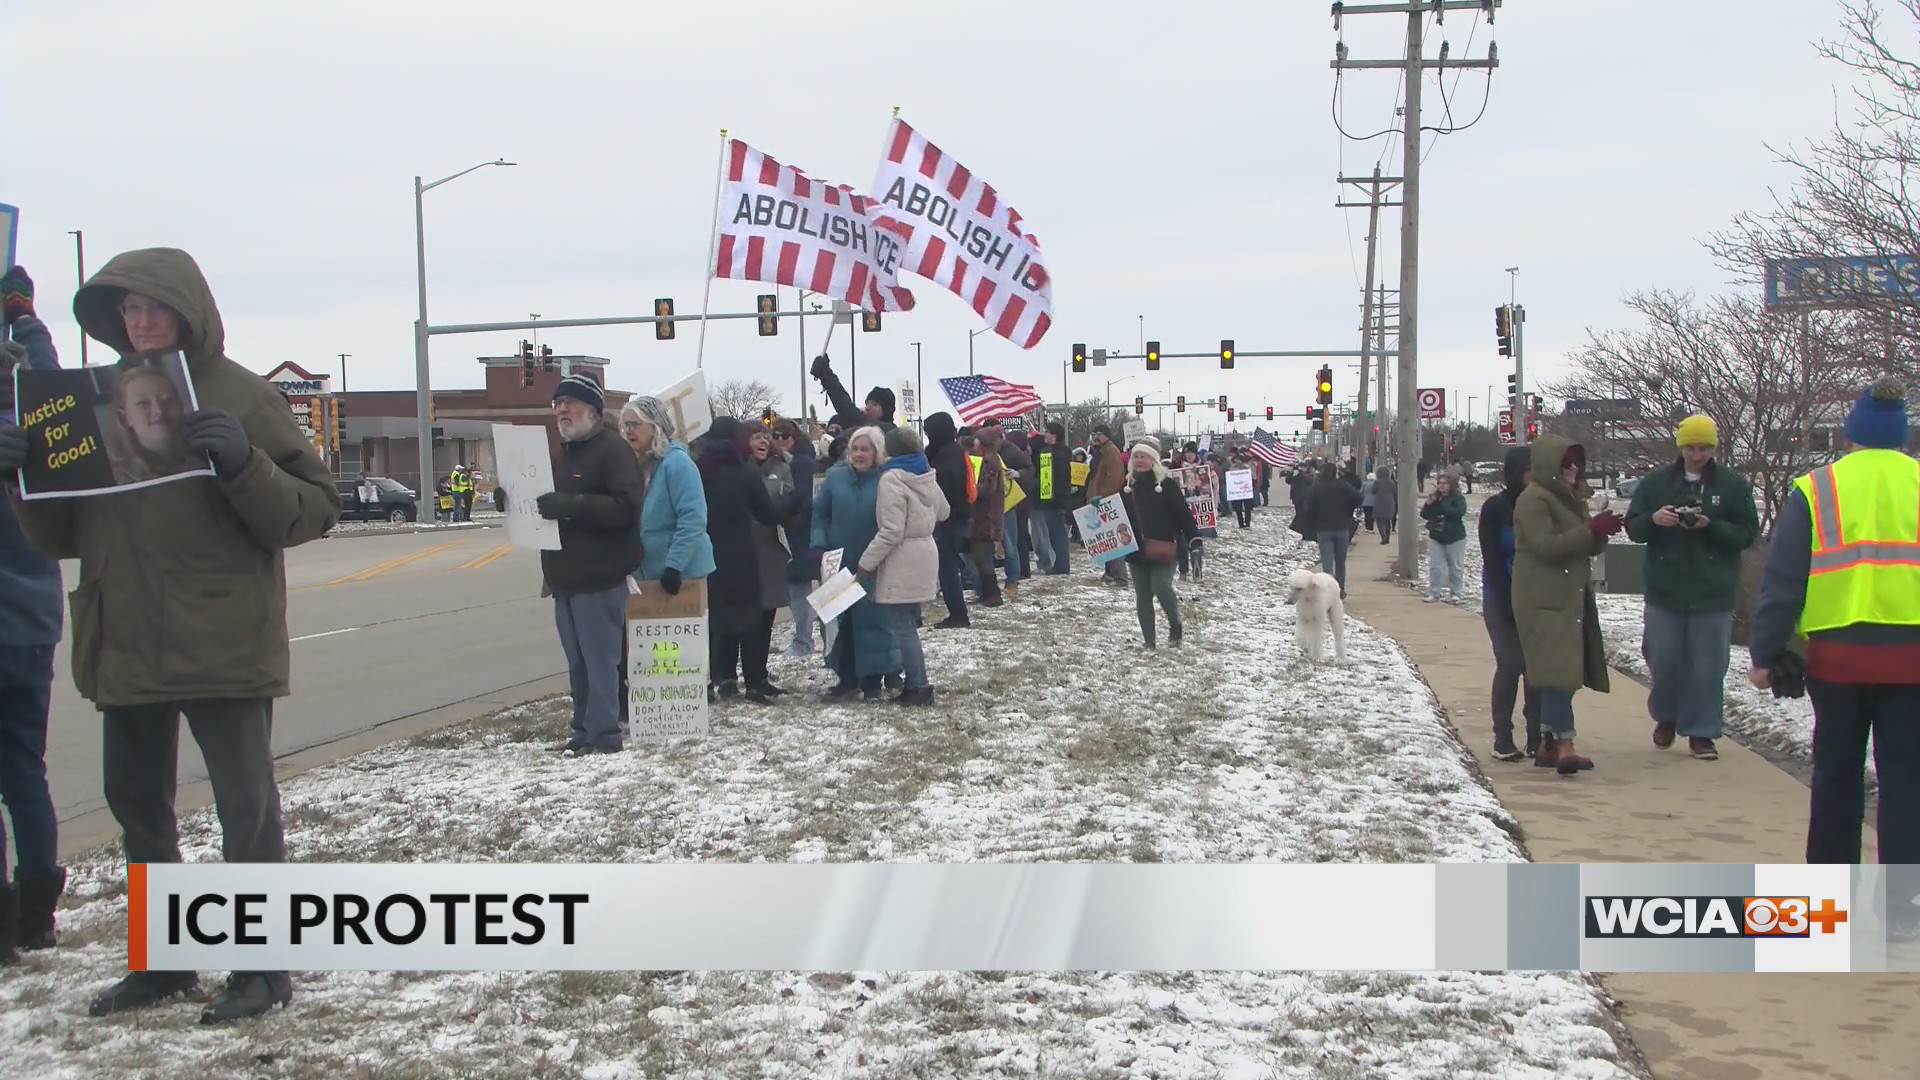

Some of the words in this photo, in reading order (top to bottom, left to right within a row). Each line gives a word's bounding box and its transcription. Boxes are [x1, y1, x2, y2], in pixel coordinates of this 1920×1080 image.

[733, 193, 867, 254] ABOLISH
[875, 231, 900, 276] ICE
[882, 177, 1014, 270] ABOLISH
[1013, 254, 1046, 291] IC
[23, 394, 76, 430] Justice
[44, 422, 70, 447] for
[47, 435, 97, 469] Good!
[1097, 500, 1113, 513] AT&T
[1108, 509, 1119, 521] ICE
[1195, 501, 1213, 513] YOU
[1095, 531, 1105, 541] MY
[1088, 537, 1118, 557] CRUSHED
[636, 624, 700, 637] RESTORE
[631, 686, 656, 703] NO
[635, 704, 663, 715] DON'T
[670, 703, 700, 713] ALLOW
